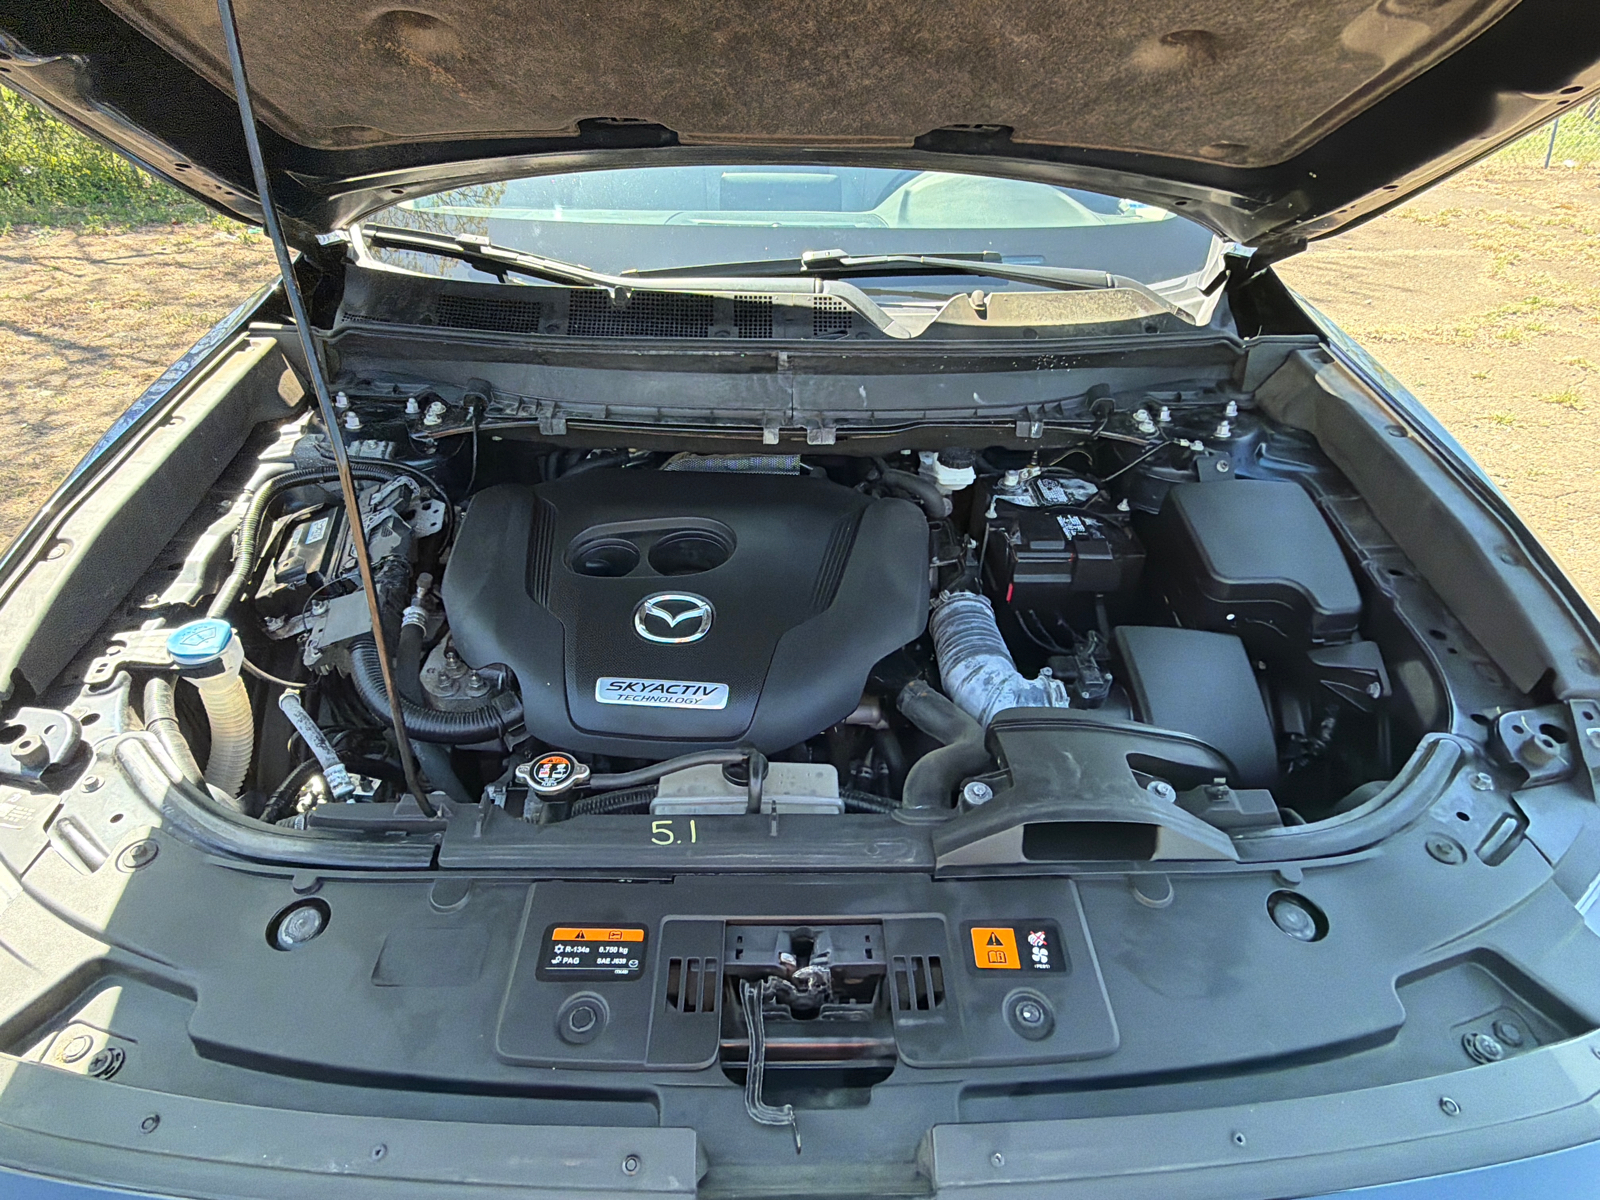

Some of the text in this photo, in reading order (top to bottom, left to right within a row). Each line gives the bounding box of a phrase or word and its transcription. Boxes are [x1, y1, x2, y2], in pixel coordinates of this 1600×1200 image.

[606, 681, 719, 696] SKYACTIV
[617, 693, 703, 704] TECHNOLOGY
[651, 819, 697, 846] 5.1
[565, 945, 590, 953] R-134a
[619, 946, 628, 954] kg
